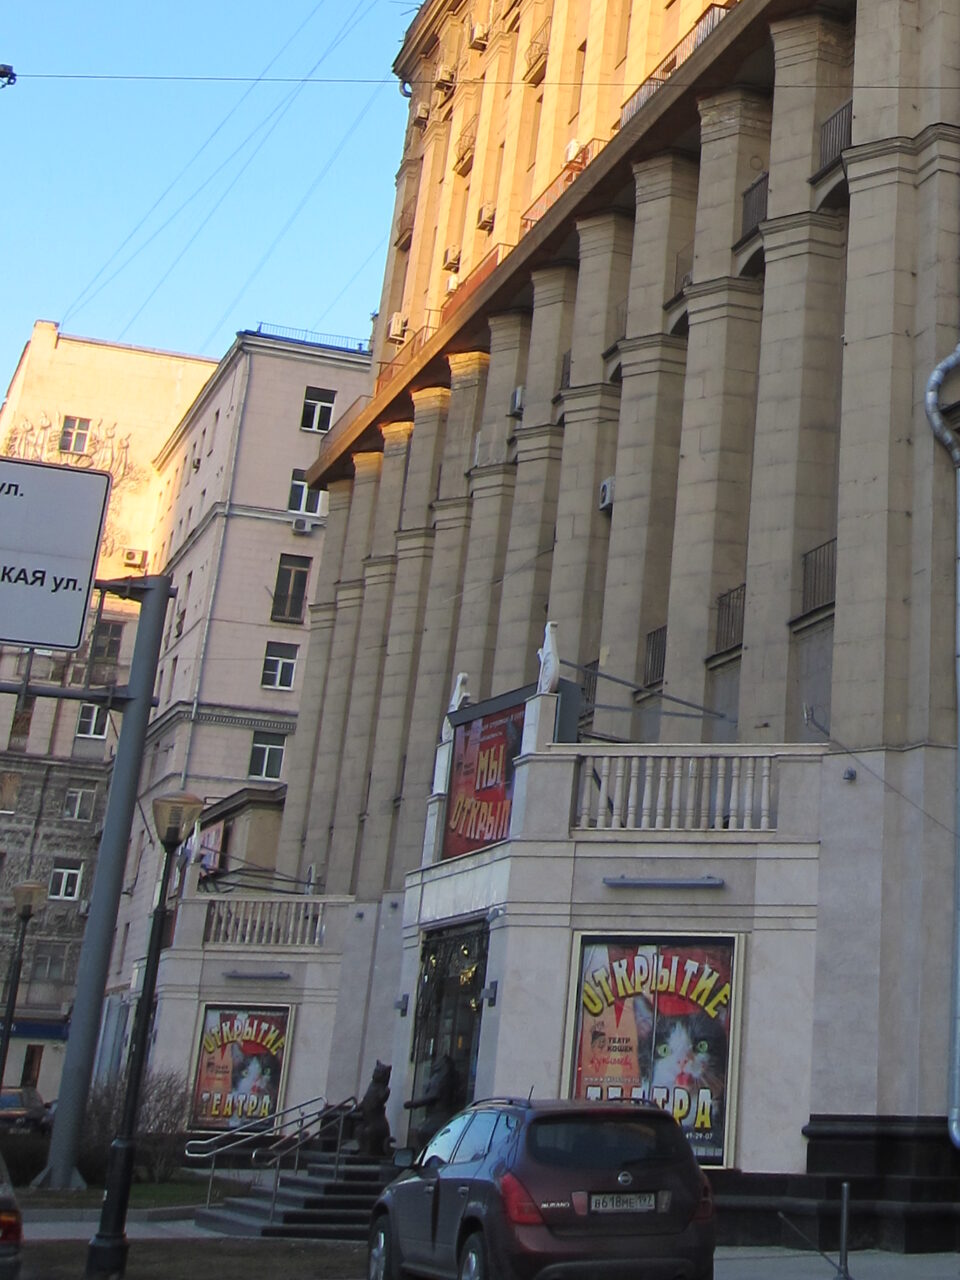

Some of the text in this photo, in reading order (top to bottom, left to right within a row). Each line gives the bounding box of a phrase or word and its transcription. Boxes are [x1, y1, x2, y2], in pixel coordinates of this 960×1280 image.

[51, 576, 82, 592] ул.
[476, 744, 502, 790] МЫ
[583, 954, 731, 1018] ОТКРЫТИЕ
[204, 1019, 286, 1056] ОТКРЫТИЕ
[202, 1092, 271, 1117] ТЕАТРА
